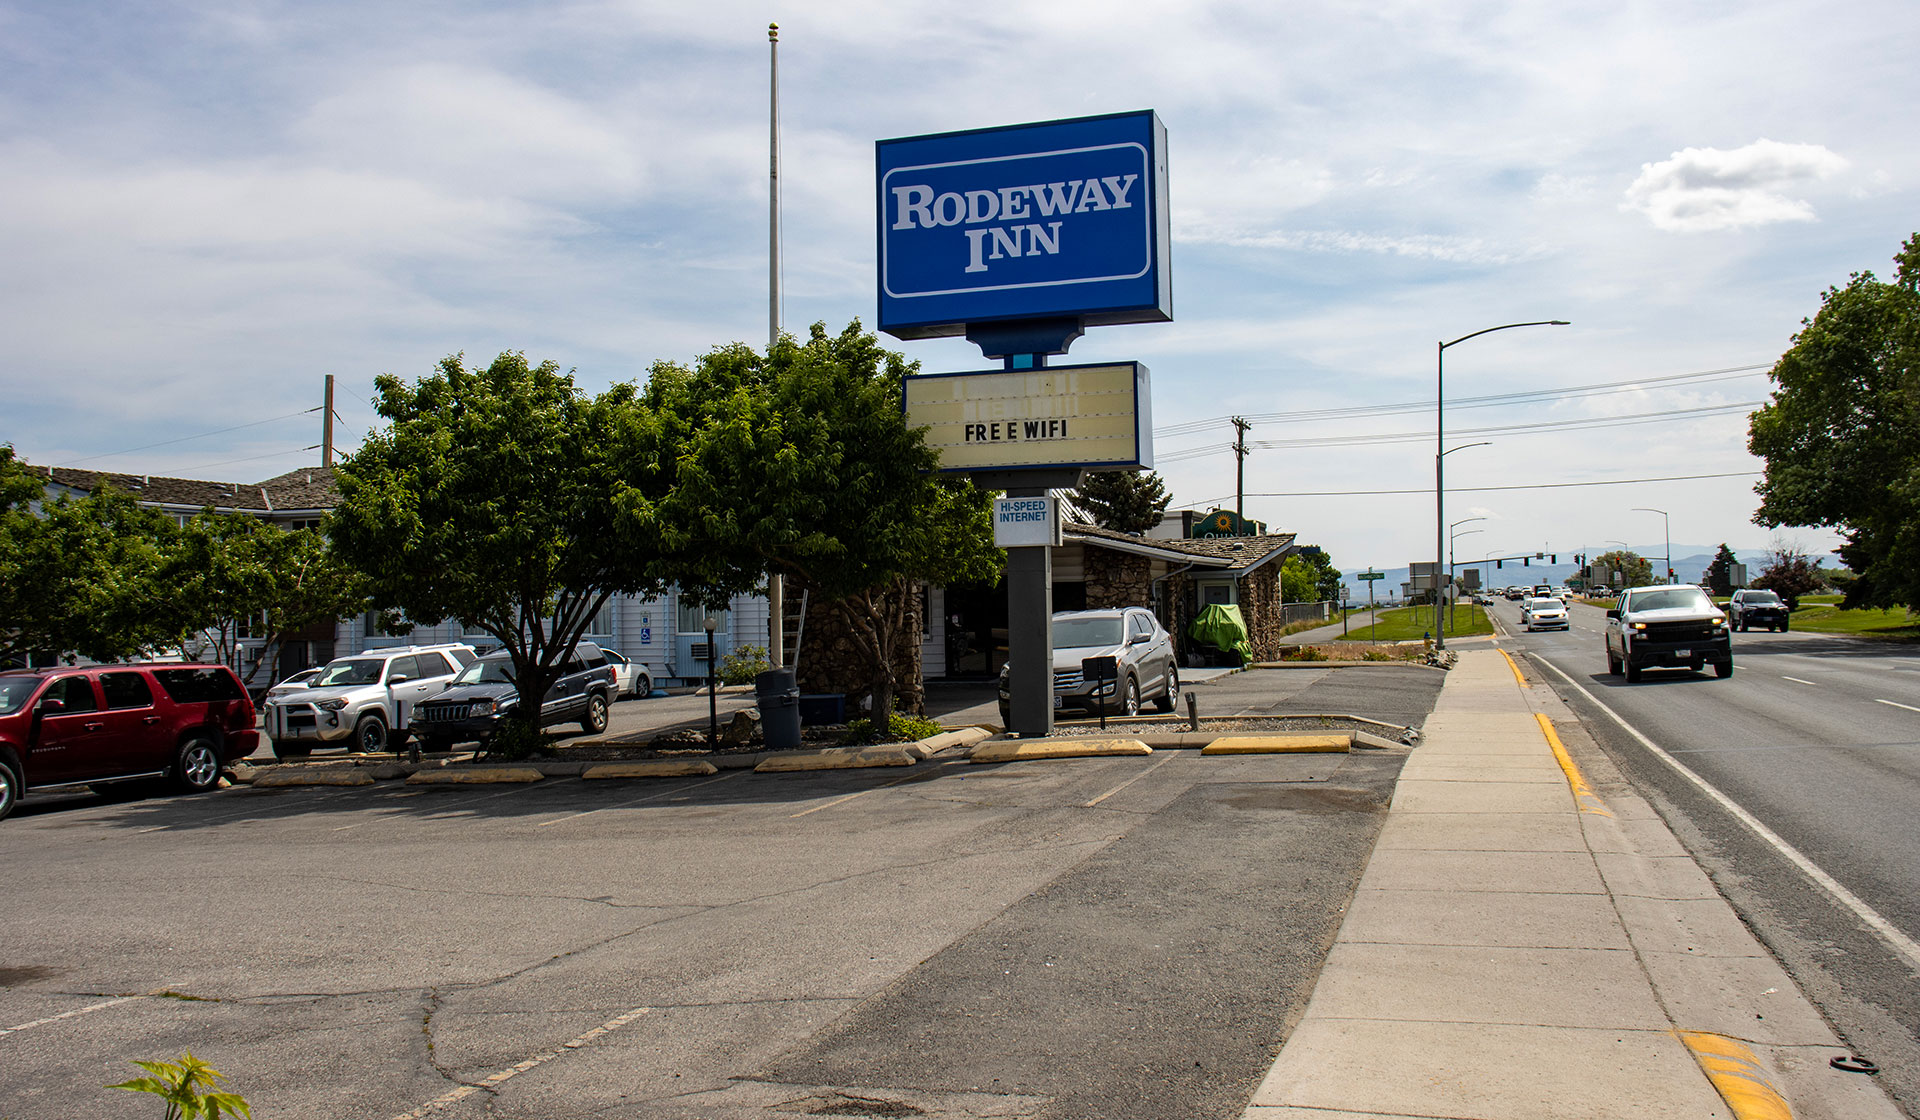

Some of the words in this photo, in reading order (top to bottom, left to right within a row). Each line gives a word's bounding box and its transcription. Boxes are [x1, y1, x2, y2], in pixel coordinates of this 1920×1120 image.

[892, 173, 1138, 231] RODEWAY
[964, 221, 1063, 273] INN
[965, 422, 1017, 441] FREE
[1024, 420, 1066, 439] WIFI
[1000, 501, 1046, 512] HI-SPEED
[1000, 511, 1047, 522] INTERNET
